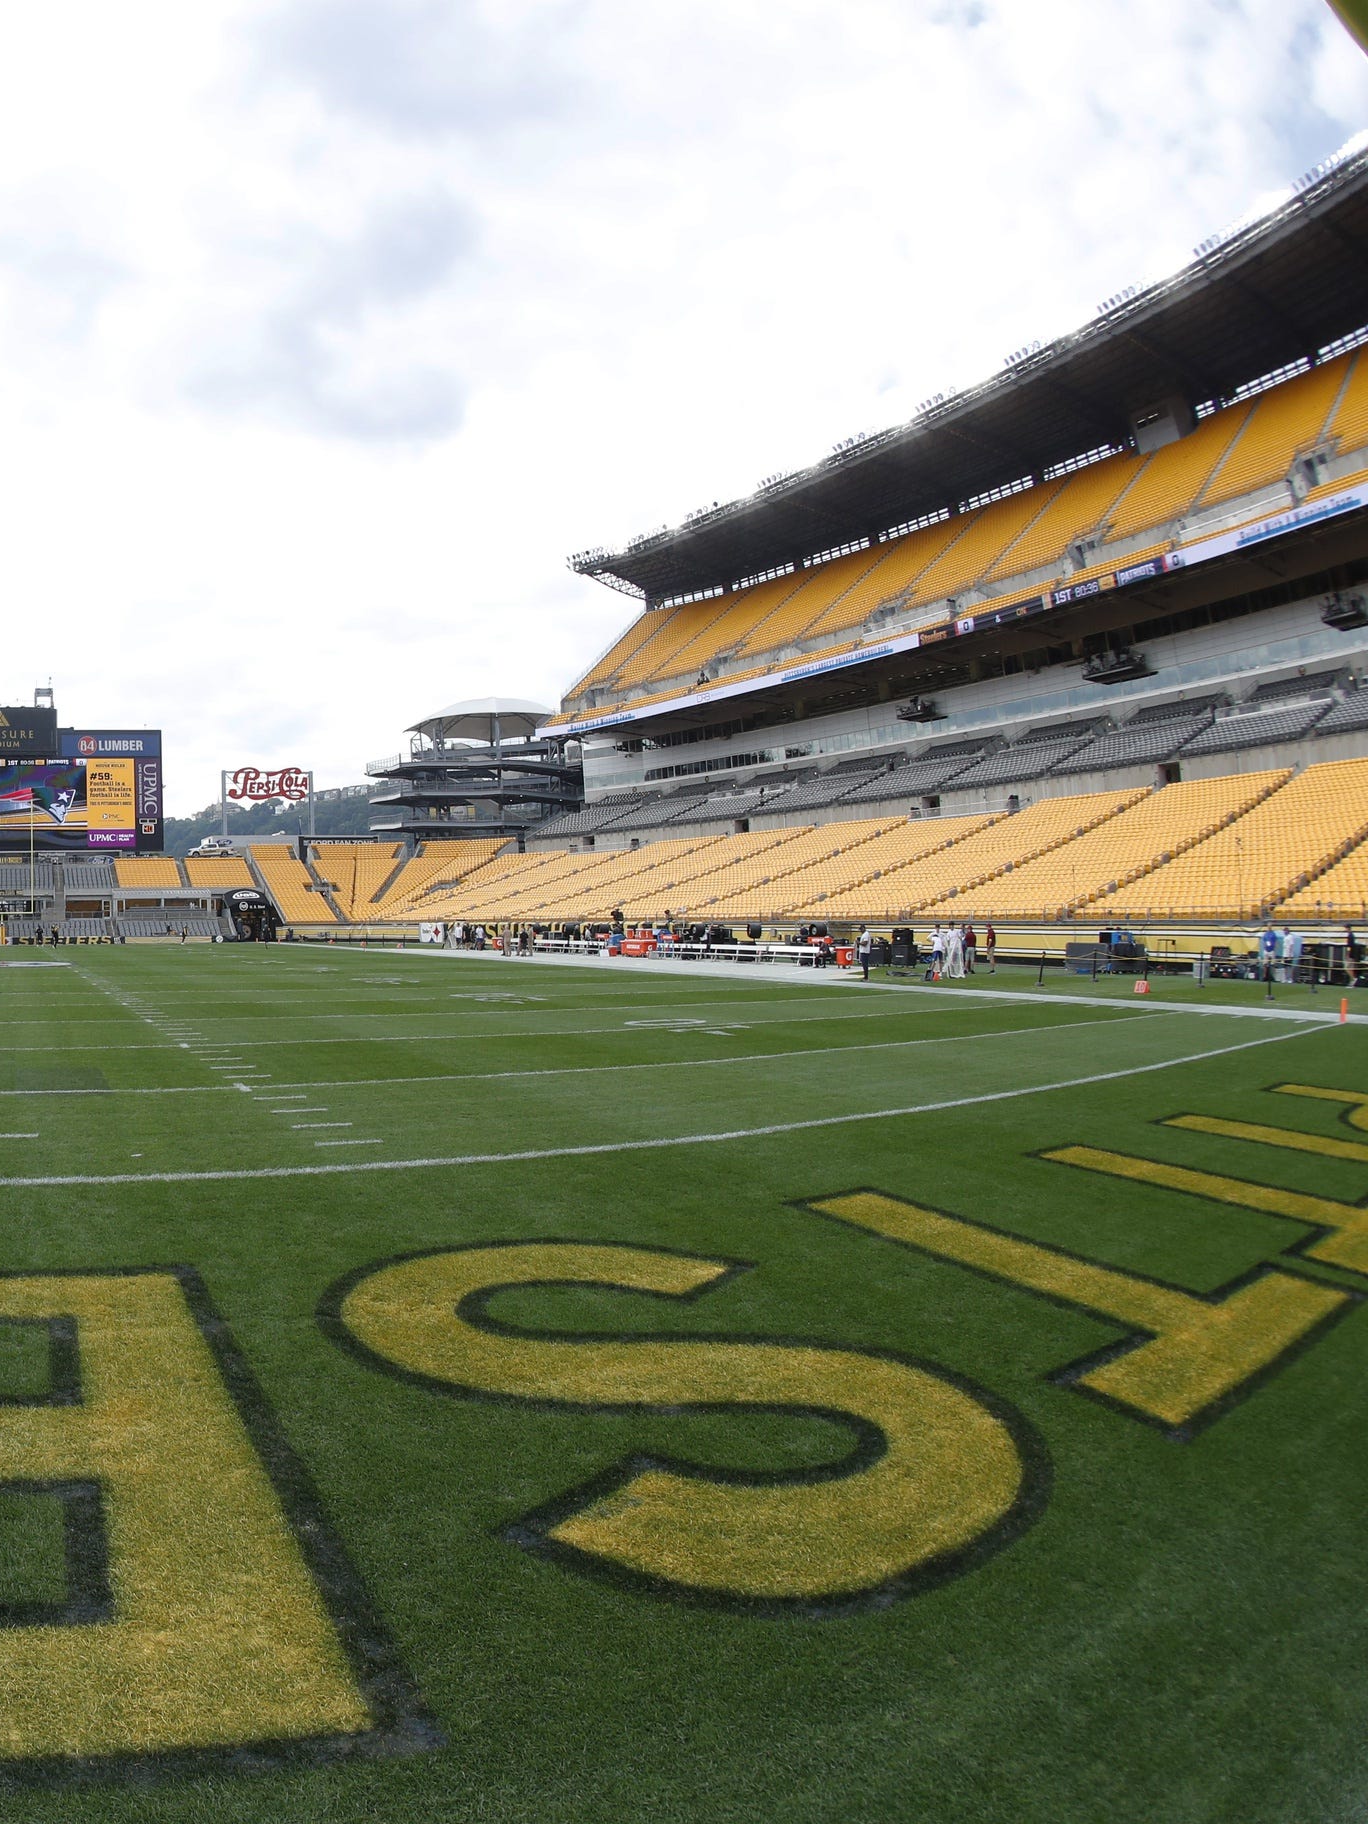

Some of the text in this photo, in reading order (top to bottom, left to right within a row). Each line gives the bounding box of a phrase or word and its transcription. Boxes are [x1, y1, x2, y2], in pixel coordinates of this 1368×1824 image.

[1172, 555, 1180, 566] 0
[1120, 562, 1156, 583] PATRIOTS
[1054, 581, 1098, 604] 1ST 80:36
[963, 621, 970, 632] 0
[919, 630, 948, 646] Steelers
[80, 740, 144, 751] 84 LUMBER
[144, 763, 158, 814] UPMC
[89, 834, 116, 842] UPMC
[19, 936, 112, 945] STEELERS
[846, 952, 852, 960] G
[1136, 982, 1145, 992] 10
